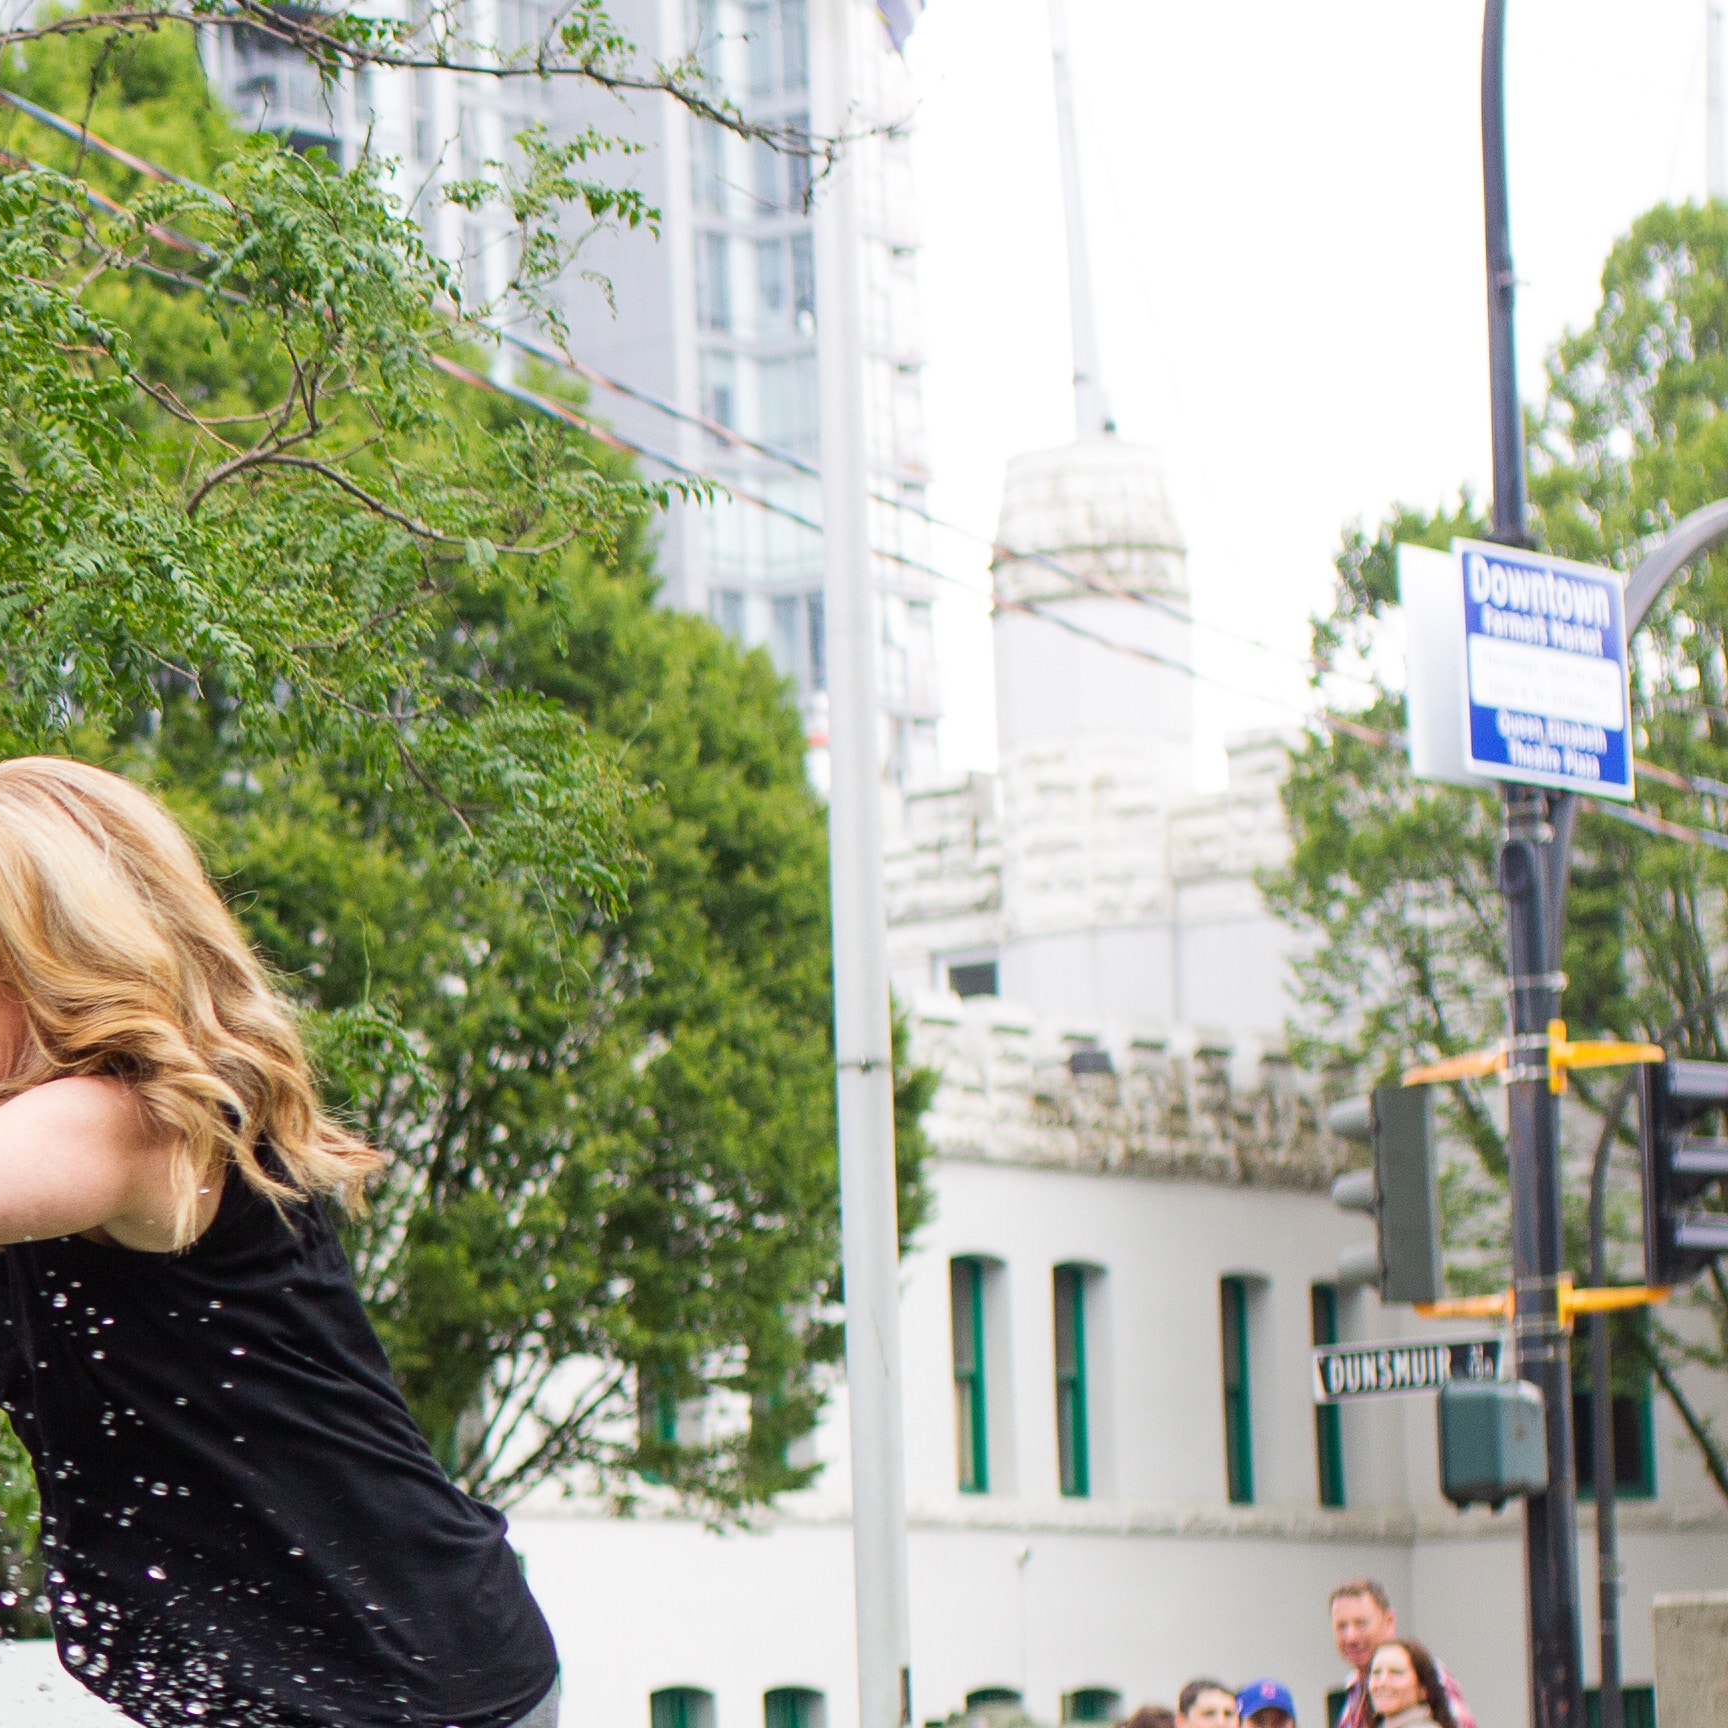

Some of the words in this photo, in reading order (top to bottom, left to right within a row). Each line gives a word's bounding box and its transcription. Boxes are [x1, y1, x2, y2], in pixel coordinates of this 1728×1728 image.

[1470, 553, 1610, 629] Downtown
[1550, 619, 1604, 657] Market
[1328, 1346, 1452, 1394] DUNSMUIR
